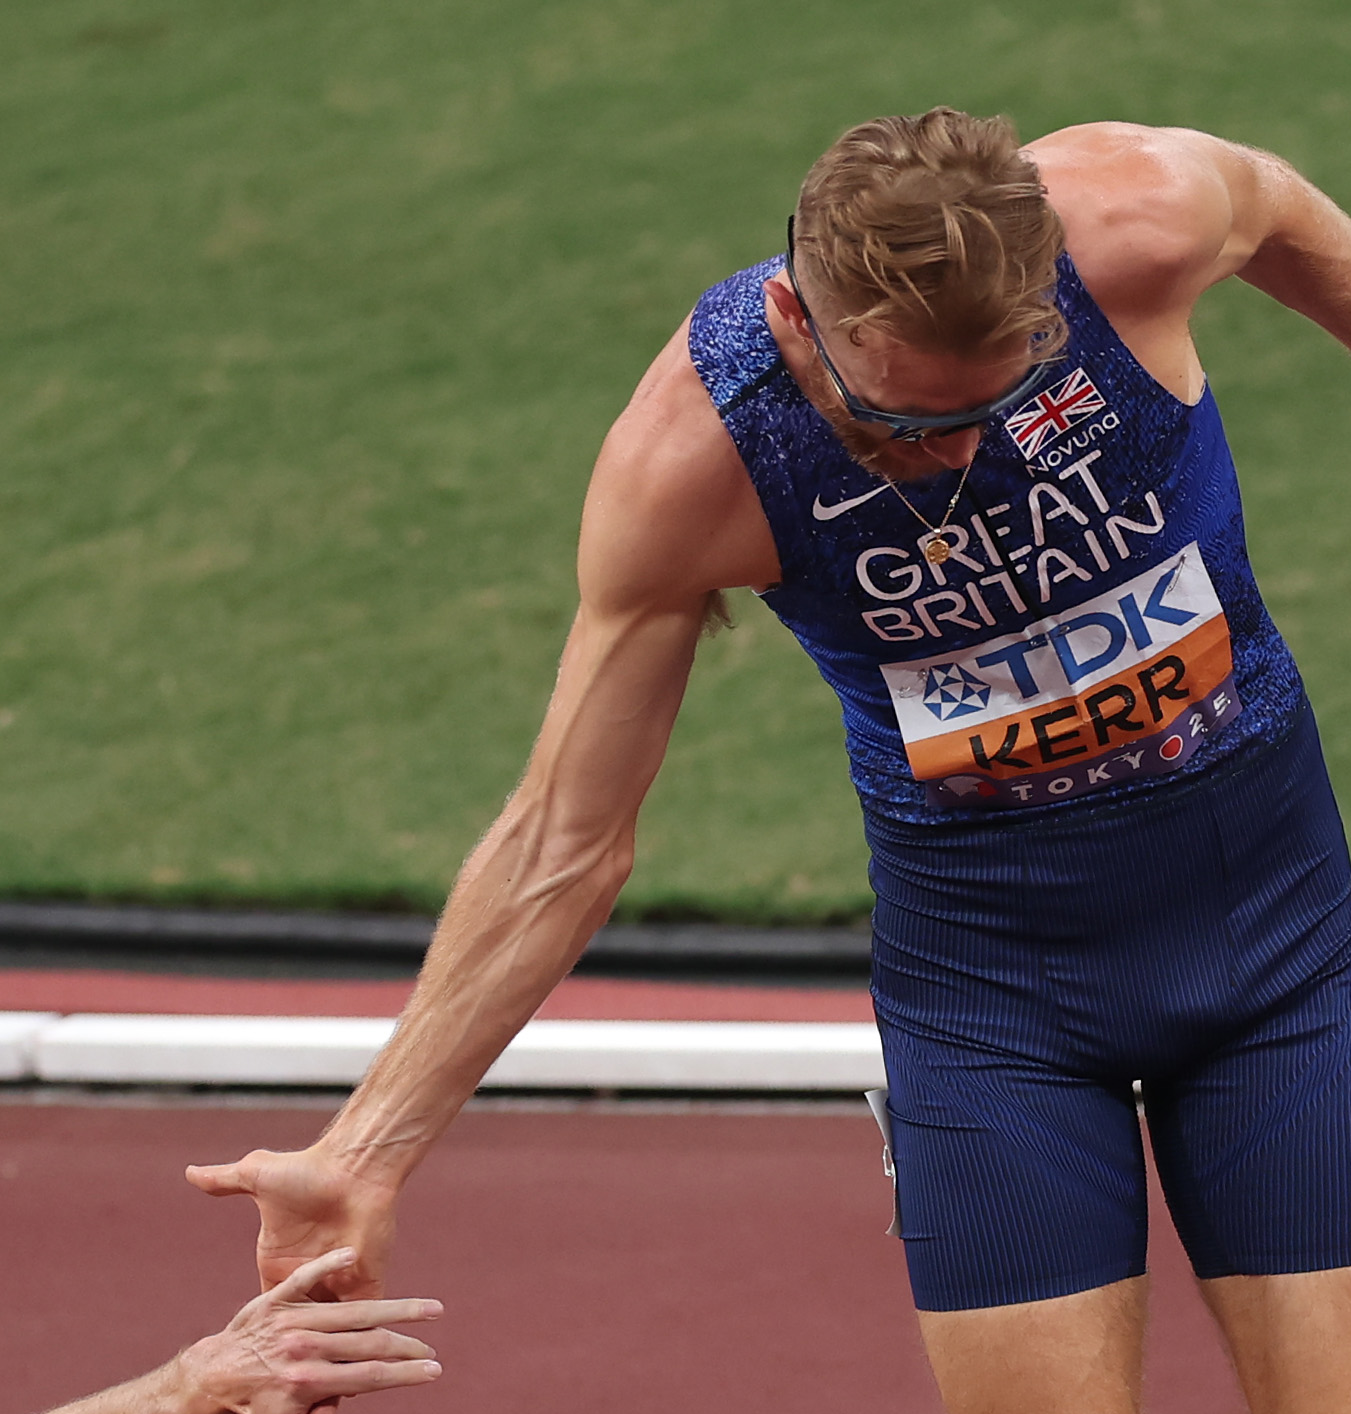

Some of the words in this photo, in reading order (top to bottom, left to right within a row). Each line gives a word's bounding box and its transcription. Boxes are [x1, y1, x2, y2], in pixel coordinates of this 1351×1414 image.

[1025, 412, 1120, 477] Novuna
[856, 449, 1110, 600] GREAT
[862, 491, 1165, 641] BRITAIN
[976, 568, 1200, 699] TDK
[969, 655, 1190, 770] KERR
